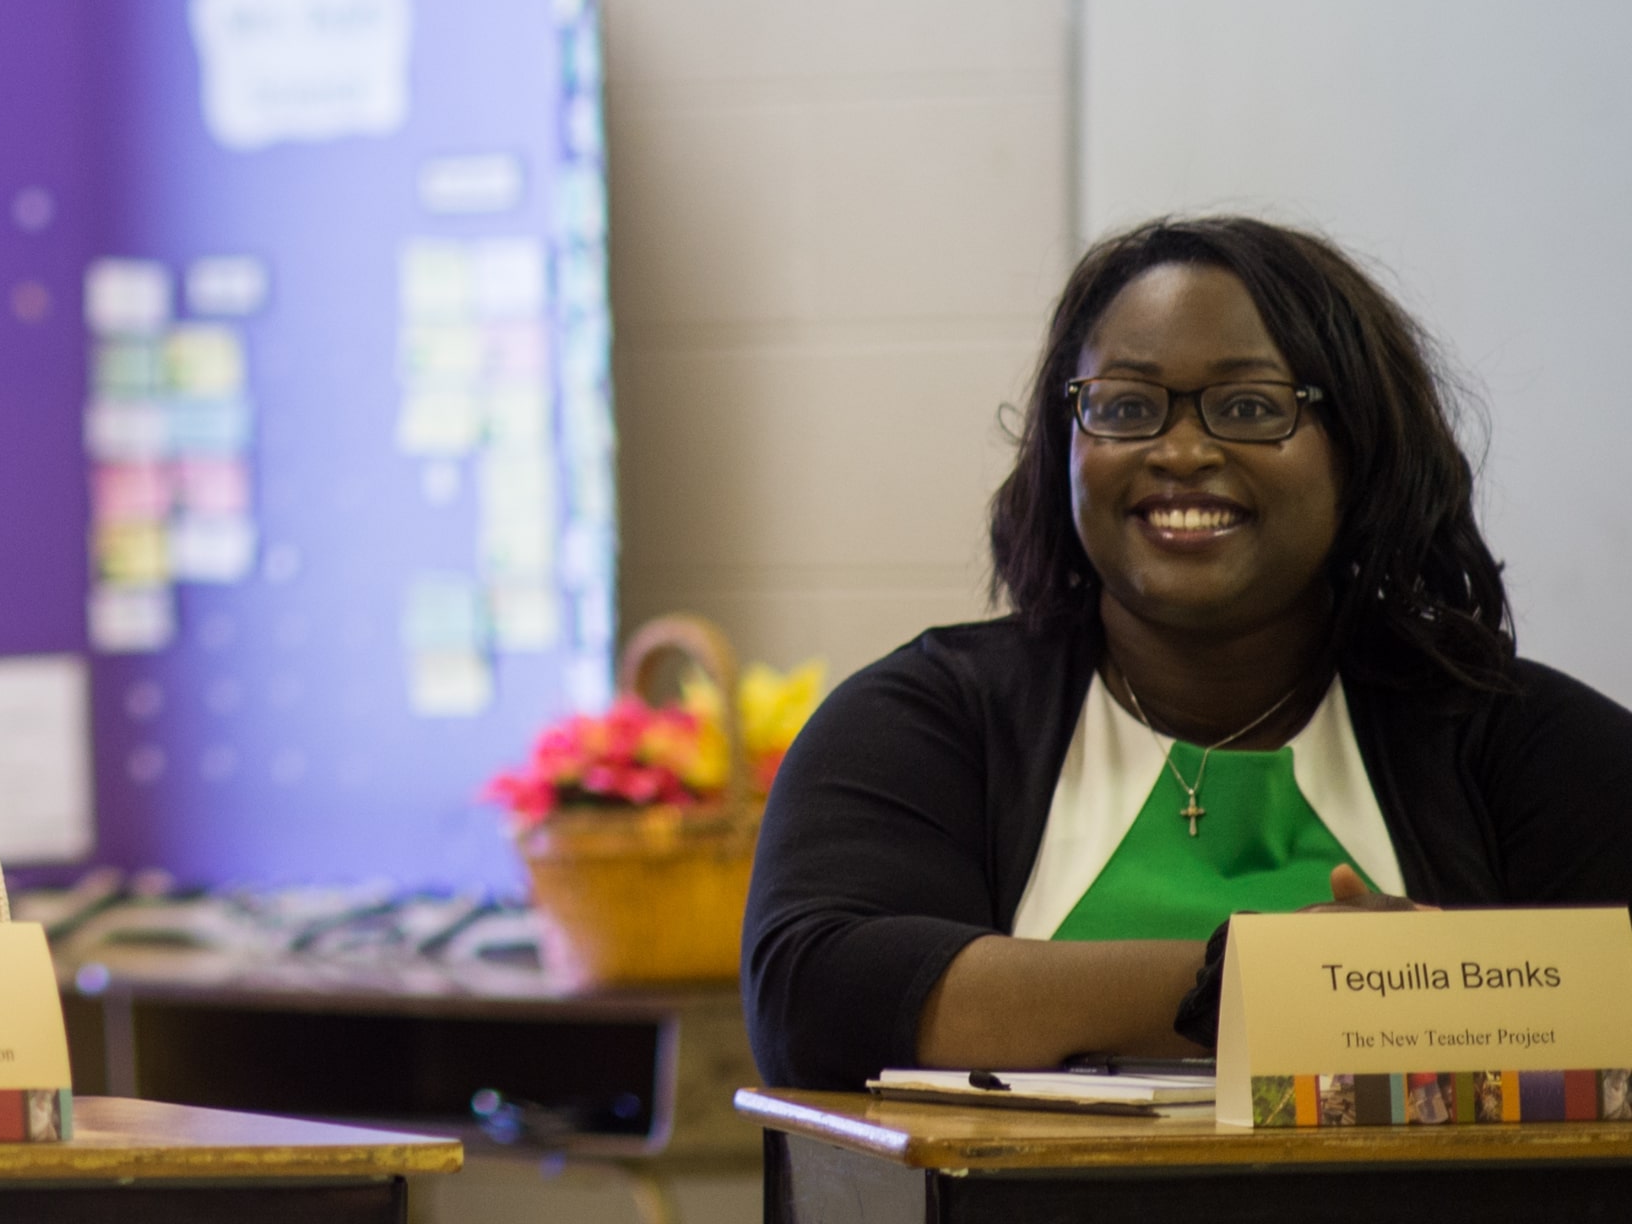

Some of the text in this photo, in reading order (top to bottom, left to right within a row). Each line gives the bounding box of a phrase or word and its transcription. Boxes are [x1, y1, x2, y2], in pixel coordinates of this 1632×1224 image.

[1321, 960, 1562, 998] Tequilla Banks
[1342, 1027, 1556, 1050] The New Teacher Project
